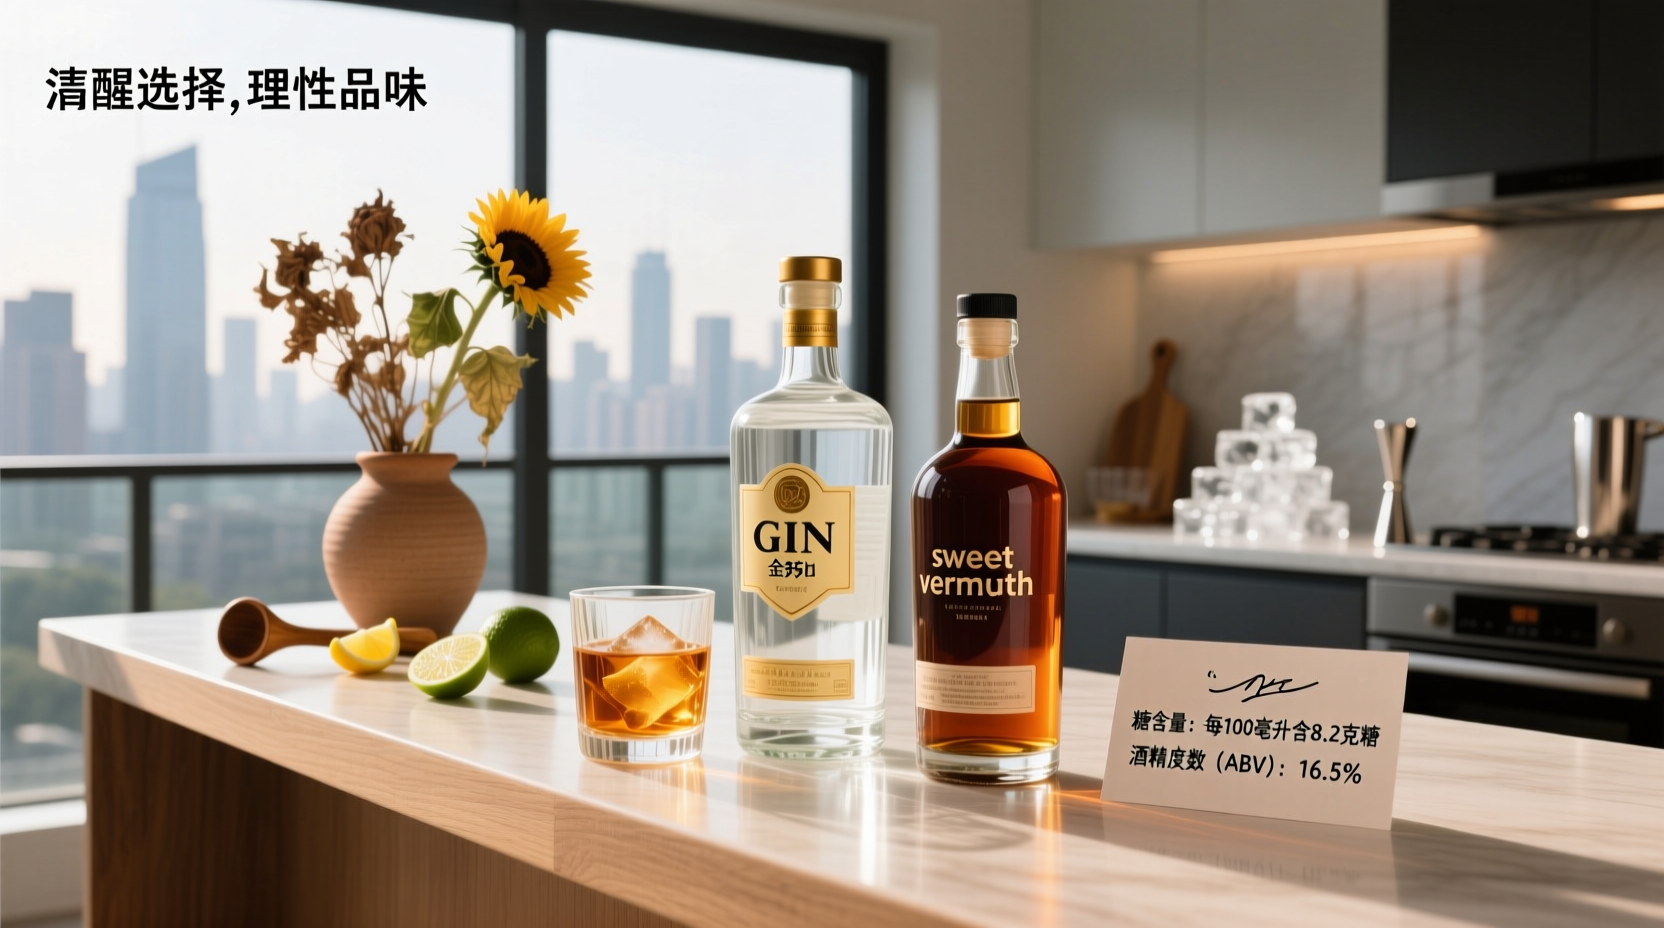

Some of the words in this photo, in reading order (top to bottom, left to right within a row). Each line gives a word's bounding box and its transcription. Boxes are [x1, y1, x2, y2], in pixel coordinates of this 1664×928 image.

[753, 520, 835, 554] GIN
[932, 546, 1014, 569] sweet
[919, 569, 1034, 597] vermuth
